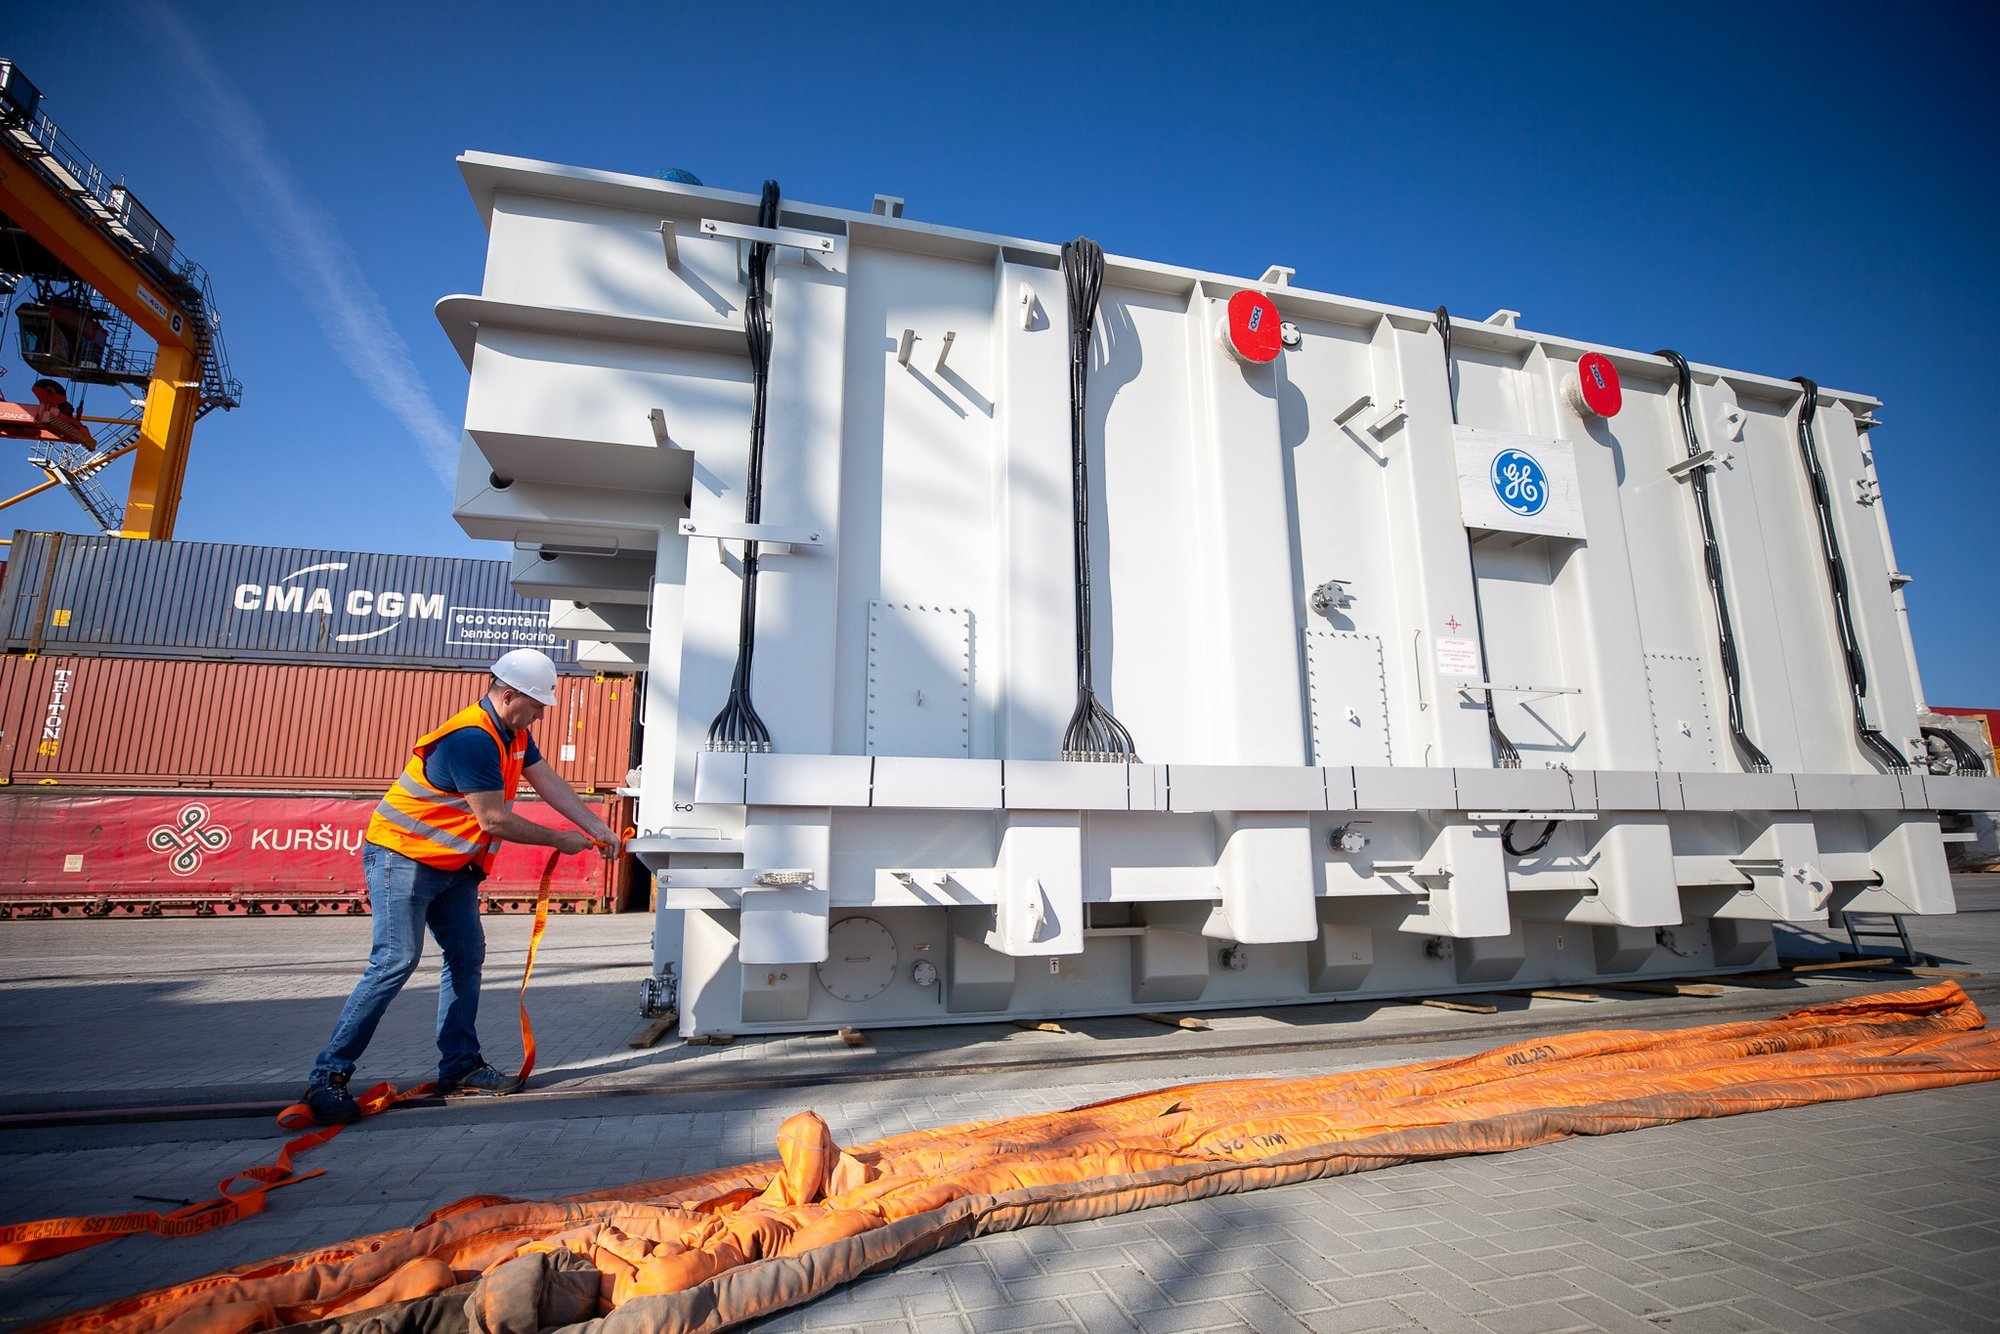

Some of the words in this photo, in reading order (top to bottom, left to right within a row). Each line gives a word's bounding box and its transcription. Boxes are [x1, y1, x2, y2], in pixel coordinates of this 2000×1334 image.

[172, 314, 182, 332] 6
[234, 584, 333, 615] CMA
[346, 590, 445, 620] CGM
[456, 614, 485, 624] eco
[488, 615, 551, 627] contain
[461, 628, 509, 640] bamboo
[512, 630, 556, 644] flooring
[42, 670, 72, 739] TRITON
[37, 741, 59, 757] 45
[251, 824, 363, 856] KURŠIŲ
